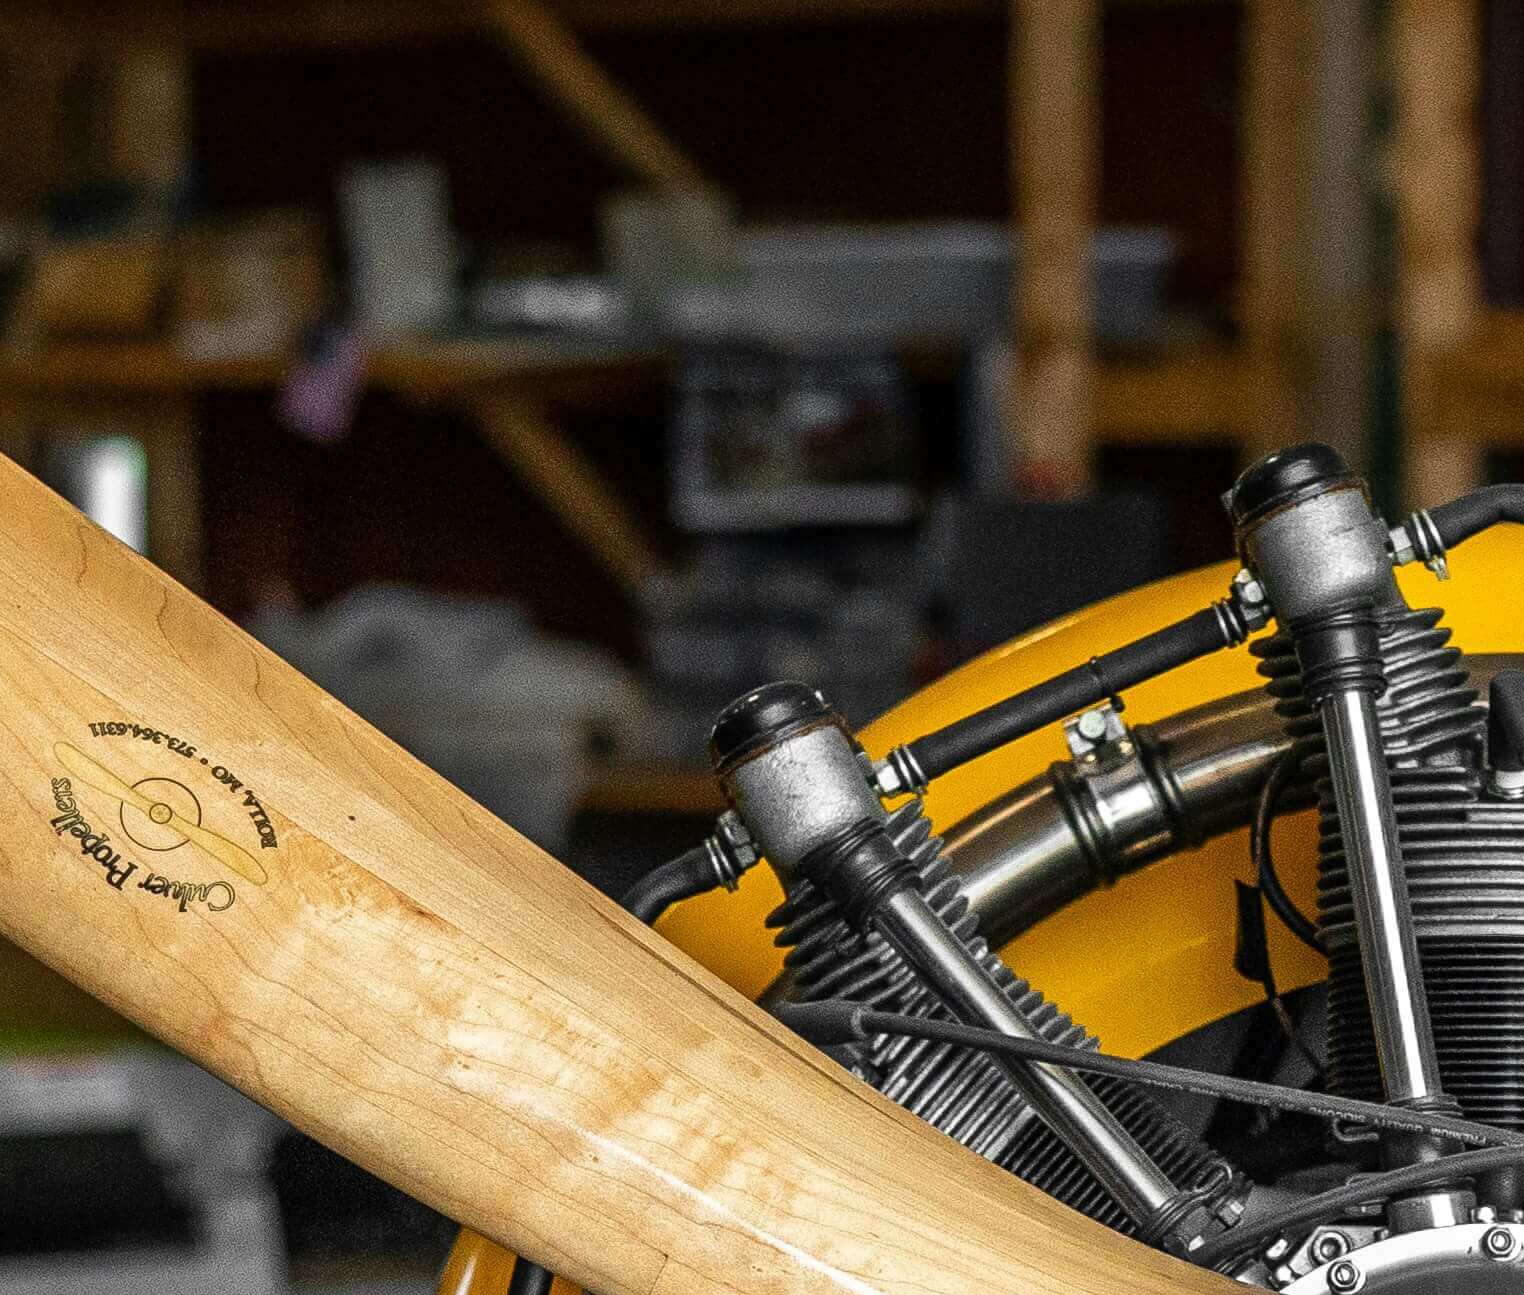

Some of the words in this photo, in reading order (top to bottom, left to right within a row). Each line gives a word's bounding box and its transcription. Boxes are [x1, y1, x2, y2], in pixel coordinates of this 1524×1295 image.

[89, 722, 197, 758] 573.364.6311
[212, 766, 243, 793] MO
[51, 777, 138, 891] Propellers
[243, 790, 278, 849] ROLLA,
[138, 873, 235, 912] Culver
